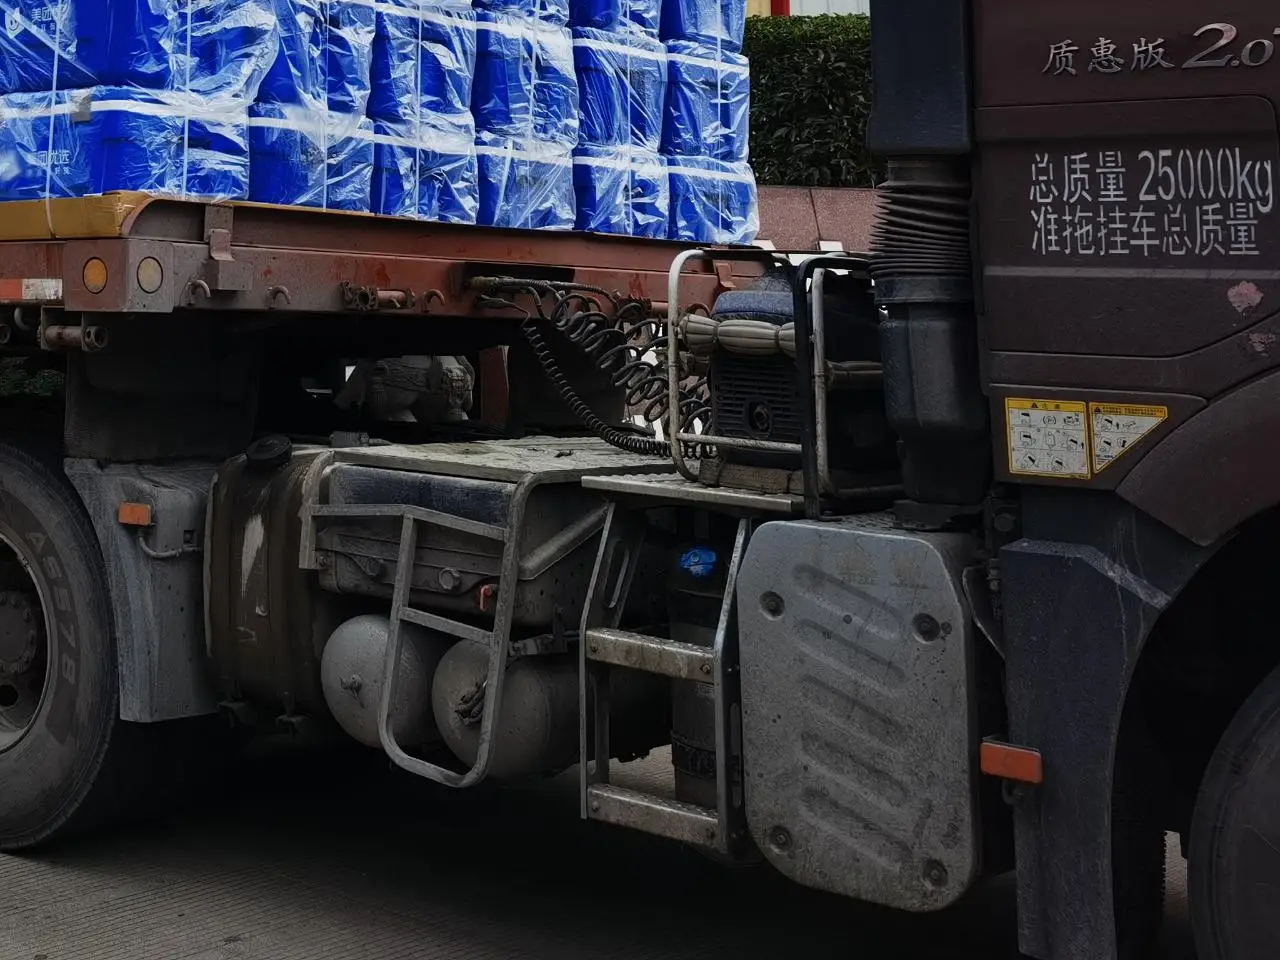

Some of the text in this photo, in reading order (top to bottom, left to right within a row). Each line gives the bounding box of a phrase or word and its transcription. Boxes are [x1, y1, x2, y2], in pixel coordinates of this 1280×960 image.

[1041, 36, 1175, 76] 质惠版
[1029, 147, 1273, 213] 总质量 25000kg
[1030, 203, 1259, 256] 准拖挂车总质量
